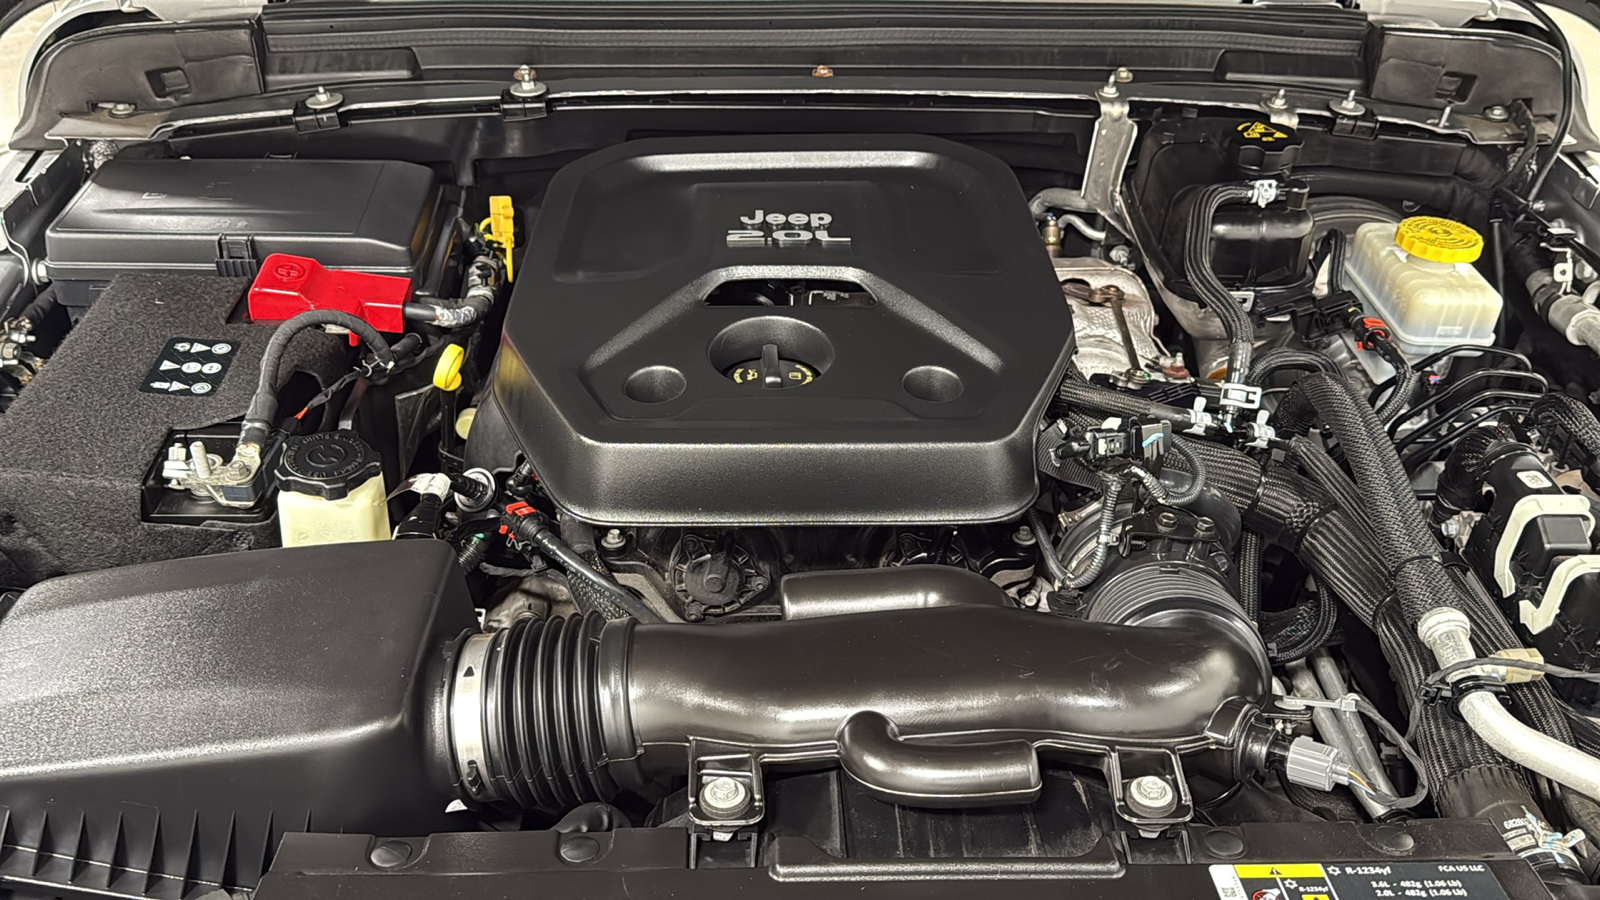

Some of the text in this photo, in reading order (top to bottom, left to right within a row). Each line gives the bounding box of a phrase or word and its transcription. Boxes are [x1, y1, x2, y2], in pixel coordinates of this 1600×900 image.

[740, 210, 832, 227] Jeep
[726, 230, 852, 243] 2.0L
[1344, 866, 1392, 876] R-1234yf
[1468, 864, 1485, 872] LLC
[1370, 880, 1391, 888] 3.6L
[1400, 880, 1423, 889] 482g
[1423, 879, 1447, 888] (1.06
[1375, 889, 1396, 897] 2.0L
[1405, 889, 1428, 898] 482g
[1428, 888, 1452, 898] (1.06
